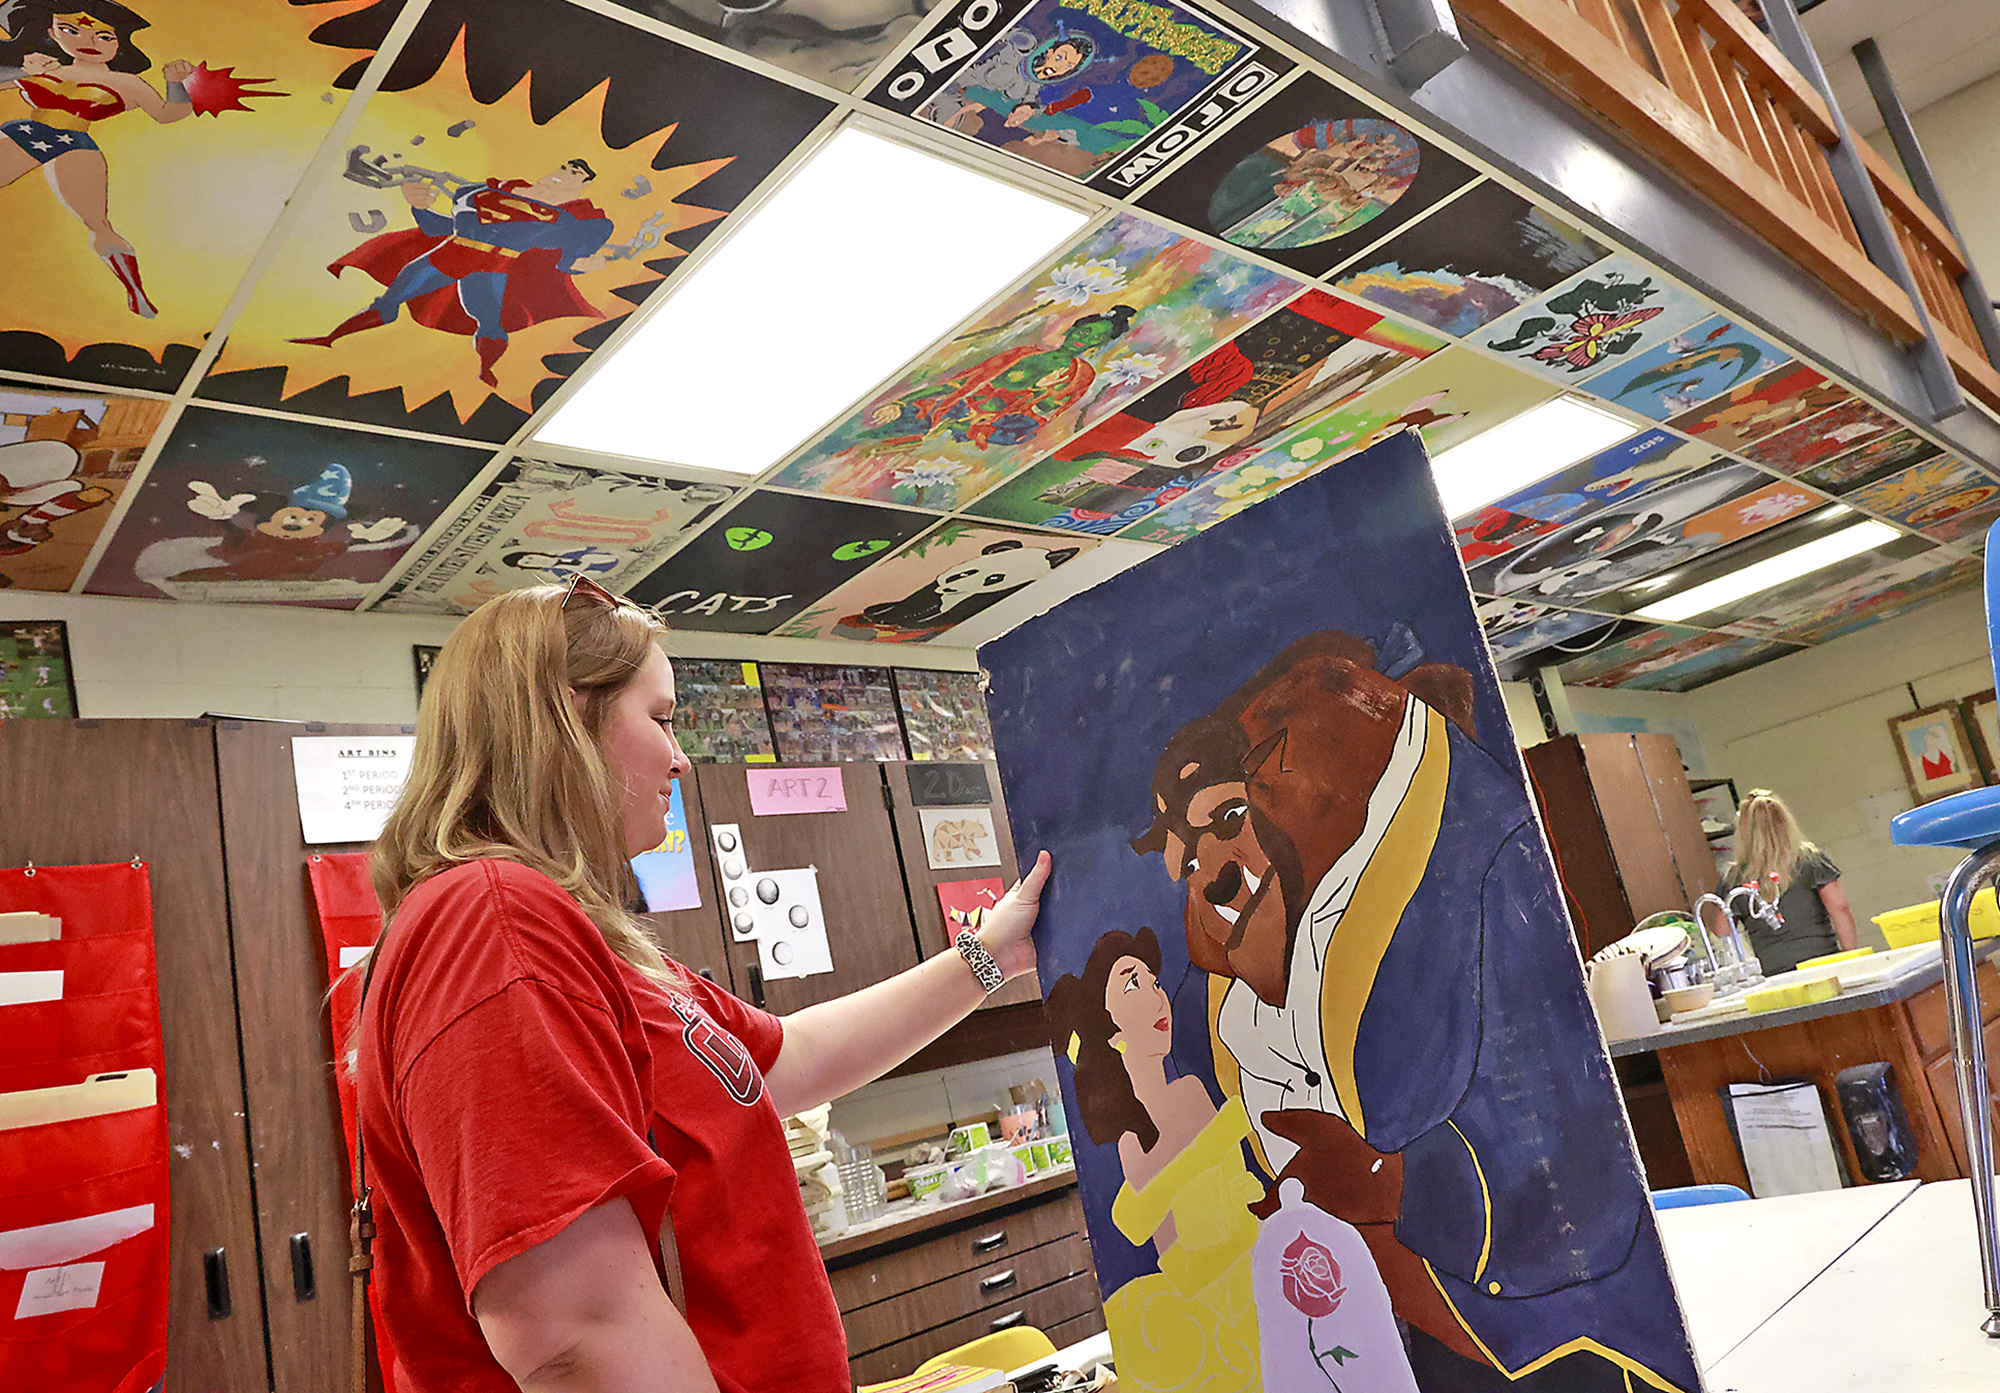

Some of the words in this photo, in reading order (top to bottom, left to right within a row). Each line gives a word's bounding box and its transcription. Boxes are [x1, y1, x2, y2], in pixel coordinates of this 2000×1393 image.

[1118, 70, 1266, 185] MOJO
[655, 590, 793, 616] CATS
[339, 749, 362, 757] ART
[368, 749, 396, 757] BINS
[359, 770, 398, 780] PERIOD
[766, 778, 811, 798] ART
[816, 777, 832, 799] 2
[363, 800, 393, 810] PERIO
